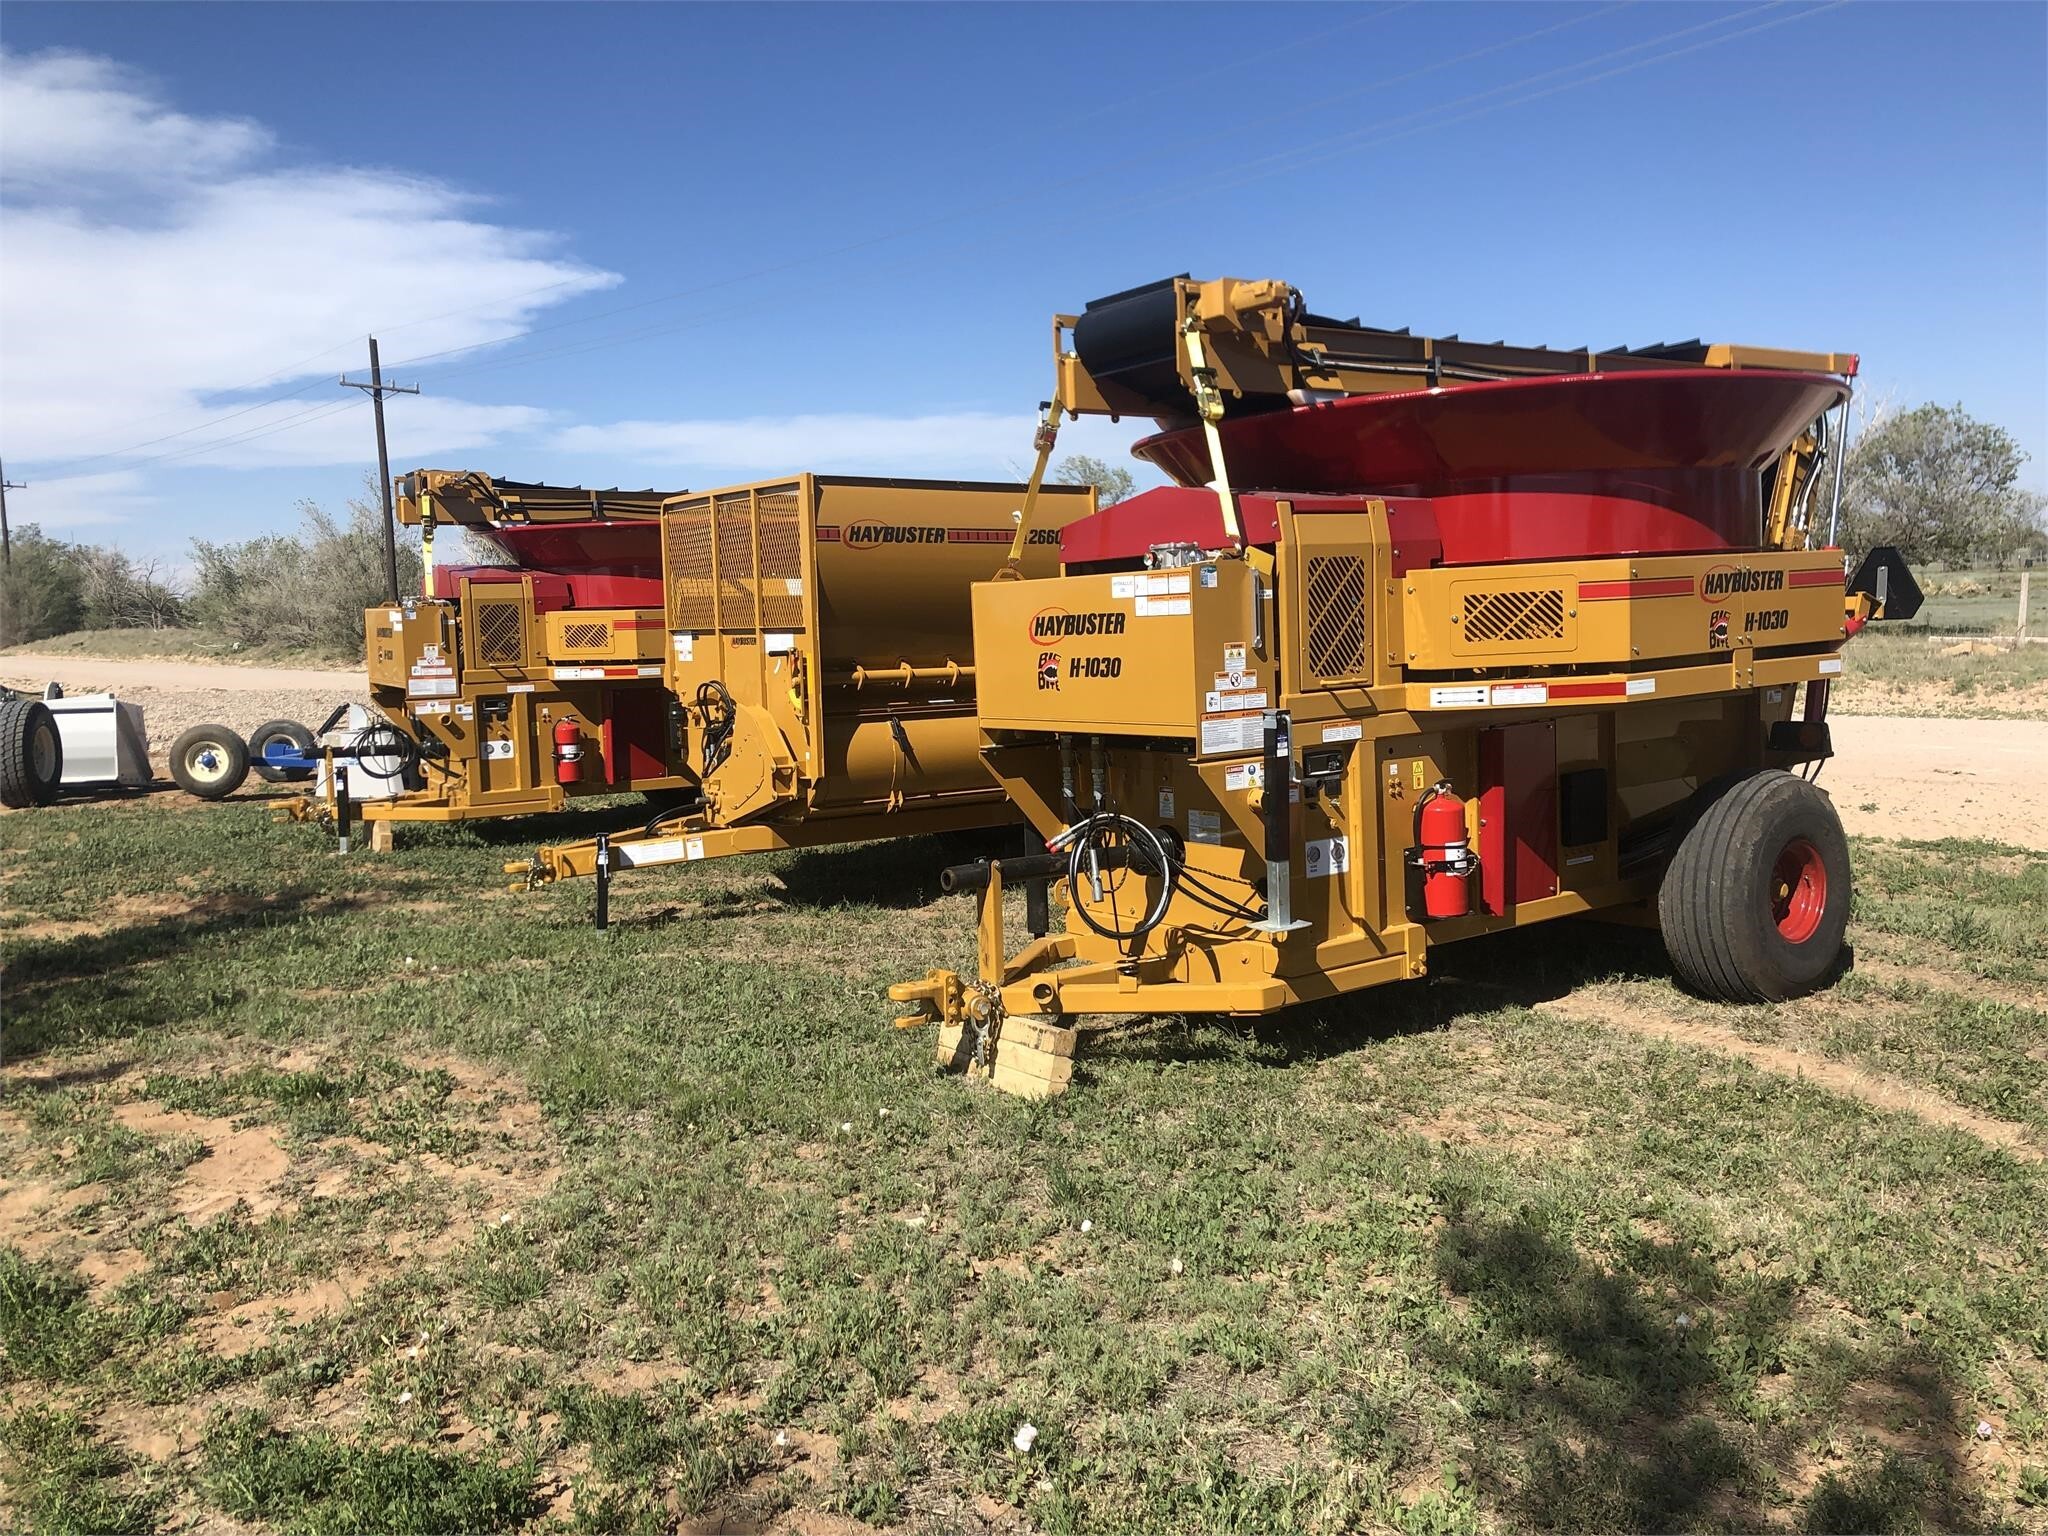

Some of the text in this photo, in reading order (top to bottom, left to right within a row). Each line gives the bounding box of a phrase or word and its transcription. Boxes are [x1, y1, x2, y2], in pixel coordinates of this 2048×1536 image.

[849, 525, 1061, 545] HAYBUSTER 2660
[1704, 569, 1784, 595] HAYBUSTER
[1034, 612, 1126, 637] HAYBUSTER
[1709, 609, 1732, 629] BIG
[1744, 609, 1789, 633] H-1030
[1709, 629, 1730, 650] BITE
[1037, 652, 1062, 670] BIG
[1069, 656, 1122, 679] H-1030
[1037, 670, 1061, 692] BITE
